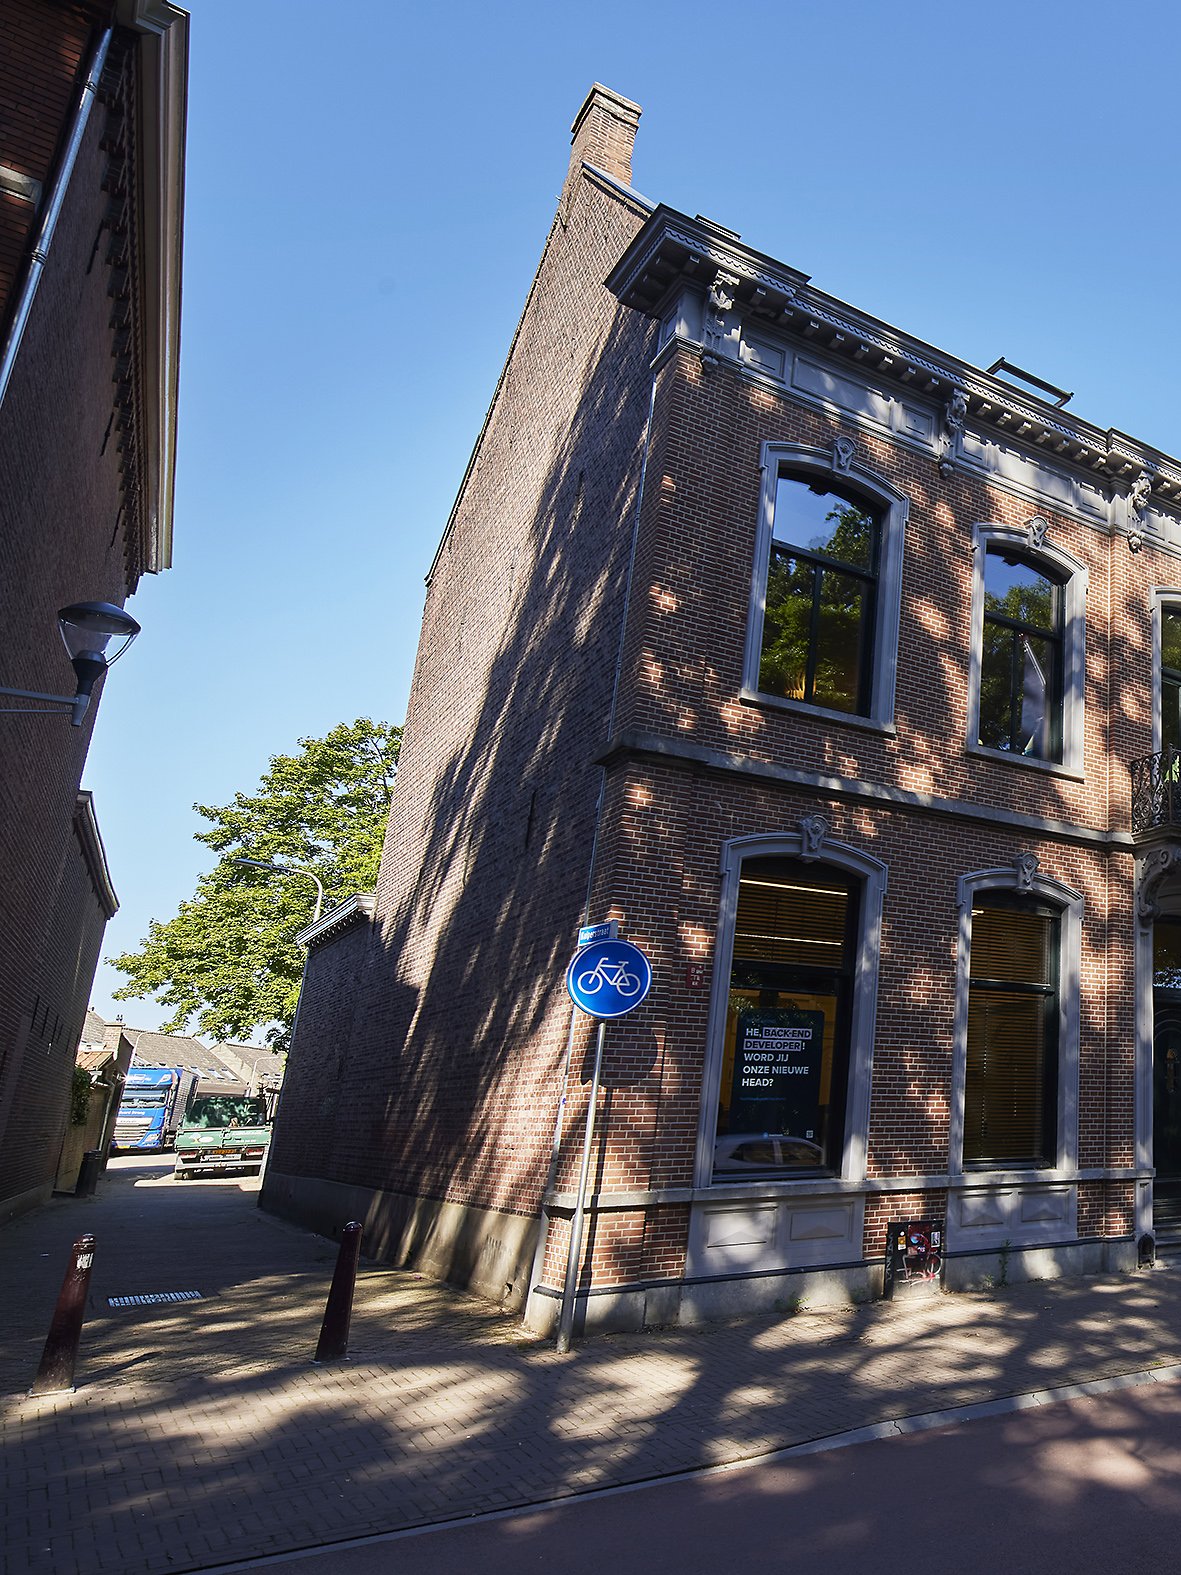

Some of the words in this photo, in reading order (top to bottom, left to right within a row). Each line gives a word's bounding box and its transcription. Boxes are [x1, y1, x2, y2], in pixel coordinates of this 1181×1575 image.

[746, 1028, 762, 1037] HE,
[764, 1029, 811, 1038] BACK-END
[744, 1053, 774, 1061] WORD
[776, 1053, 789, 1061] JIJ
[743, 1065, 770, 1074] ONZE
[771, 1066, 809, 1074] NIEUWE
[742, 1078, 774, 1087] HEAD?
